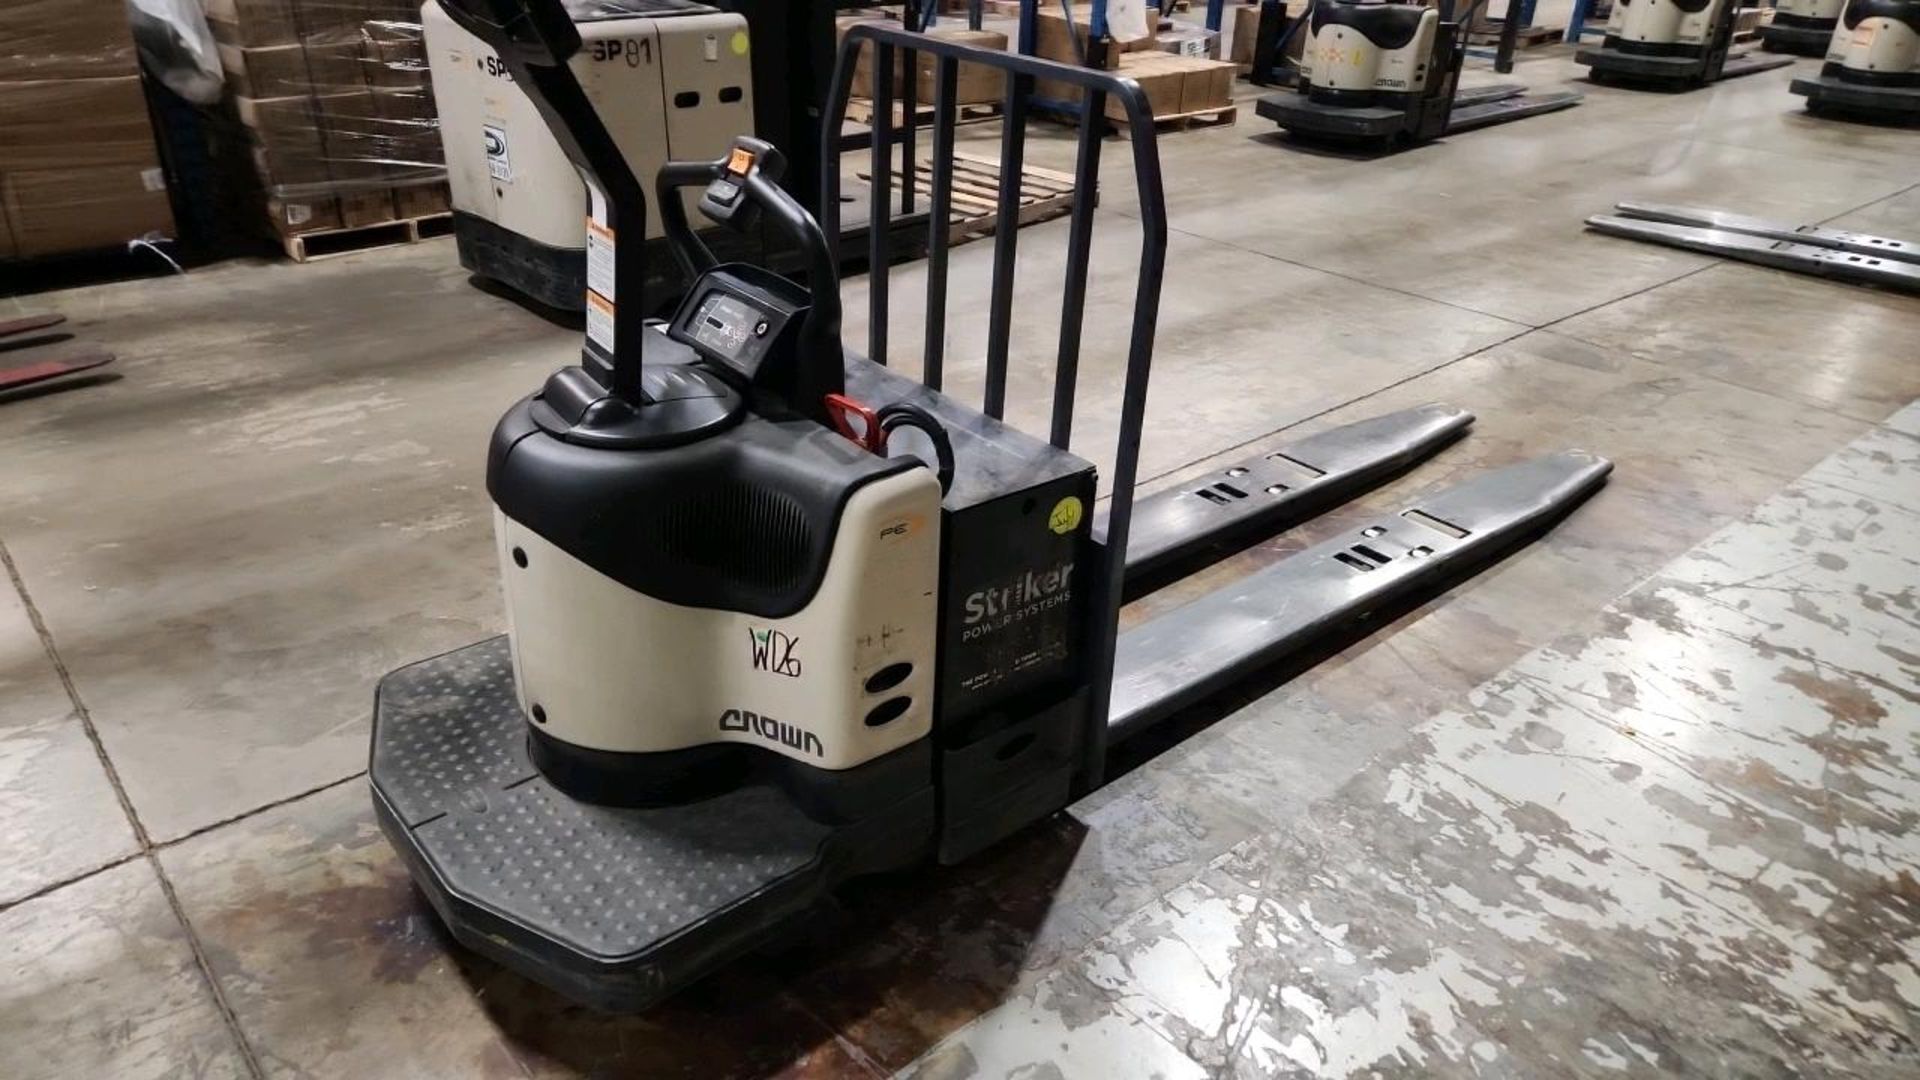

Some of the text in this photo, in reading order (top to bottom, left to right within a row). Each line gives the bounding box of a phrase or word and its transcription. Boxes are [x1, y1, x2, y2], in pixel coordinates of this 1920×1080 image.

[962, 590, 1071, 642] POWR SYSTEMS
[719, 708, 824, 758] CROWN
